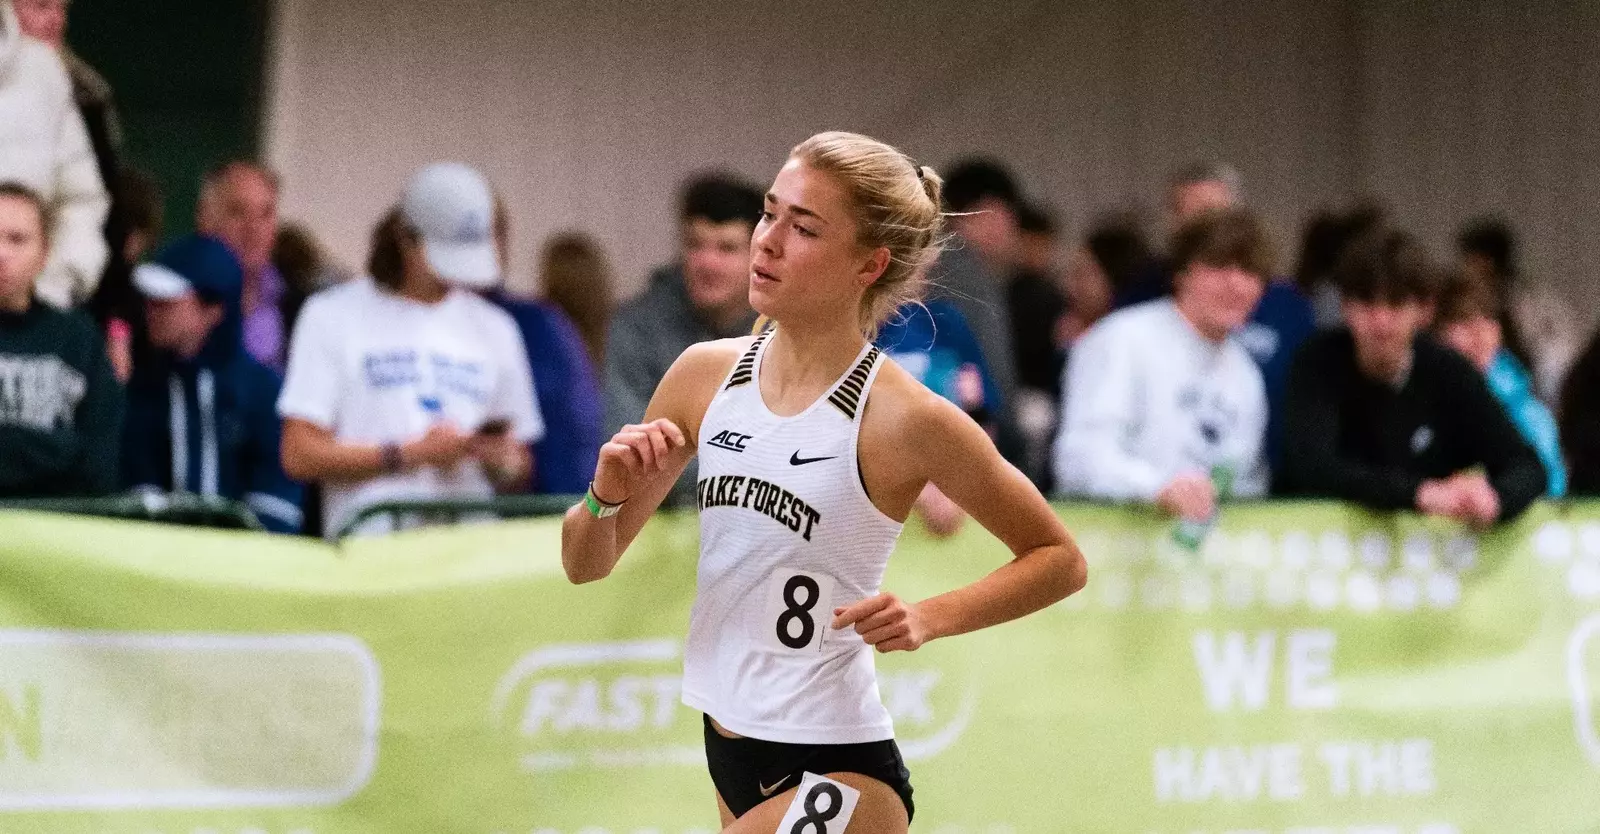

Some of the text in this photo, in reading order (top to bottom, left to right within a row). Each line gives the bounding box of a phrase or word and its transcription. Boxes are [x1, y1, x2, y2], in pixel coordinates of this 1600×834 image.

[710, 430, 753, 450] ACC
[698, 475, 820, 542] WAKE FOREST
[776, 575, 820, 649] 8
[1194, 629, 1337, 710] WE
[523, 677, 684, 735] FAST
[1154, 739, 1435, 799] HAVE THE
[790, 781, 843, 834] 8
